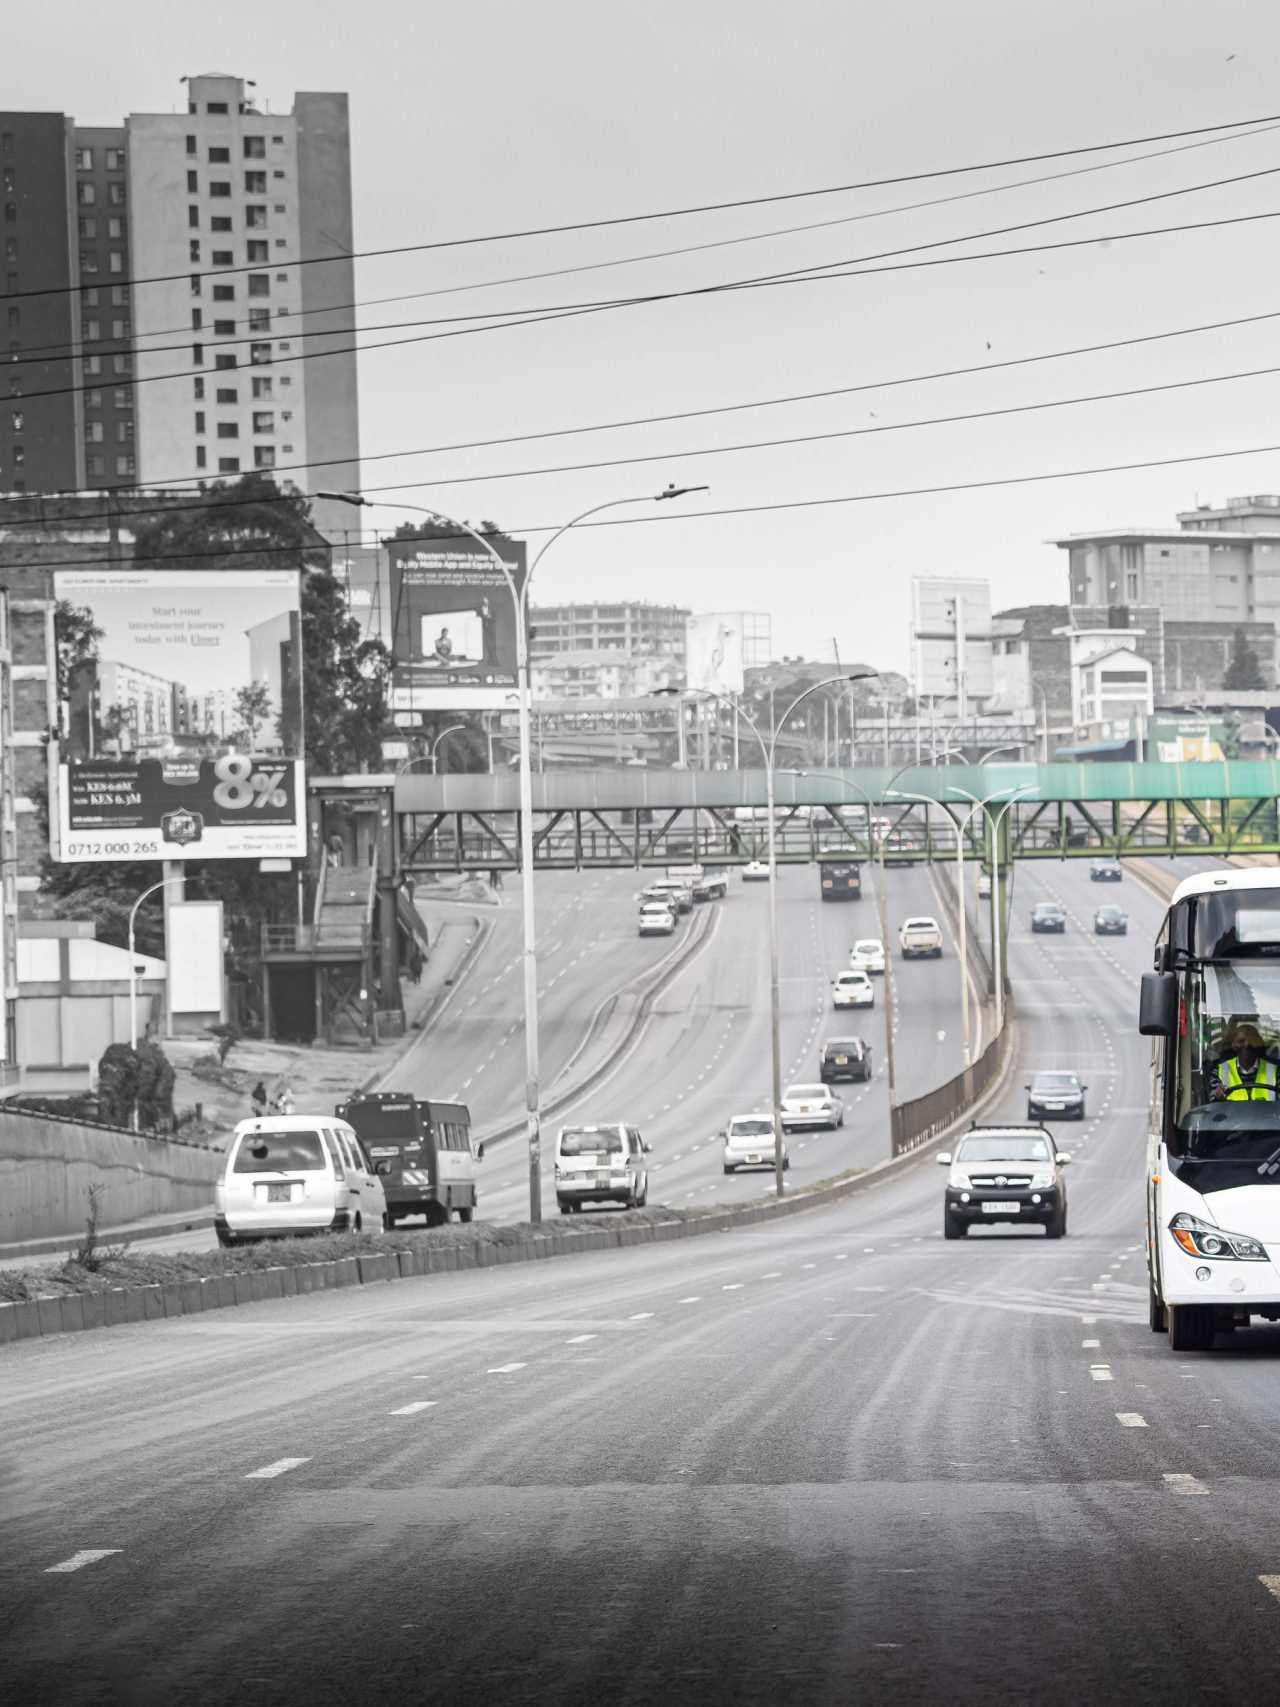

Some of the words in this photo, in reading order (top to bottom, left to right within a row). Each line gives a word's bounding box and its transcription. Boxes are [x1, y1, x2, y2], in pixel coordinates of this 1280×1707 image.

[152, 607, 177, 617] Start
[179, 609, 202, 619] your
[128, 620, 185, 630] investment
[187, 621, 225, 632] journey
[134, 634, 161, 645] today
[165, 634, 187, 644] with
[213, 754, 288, 809] 8%
[68, 843, 100, 855] 0712
[105, 842, 130, 854] 000
[133, 841, 158, 853] 265
